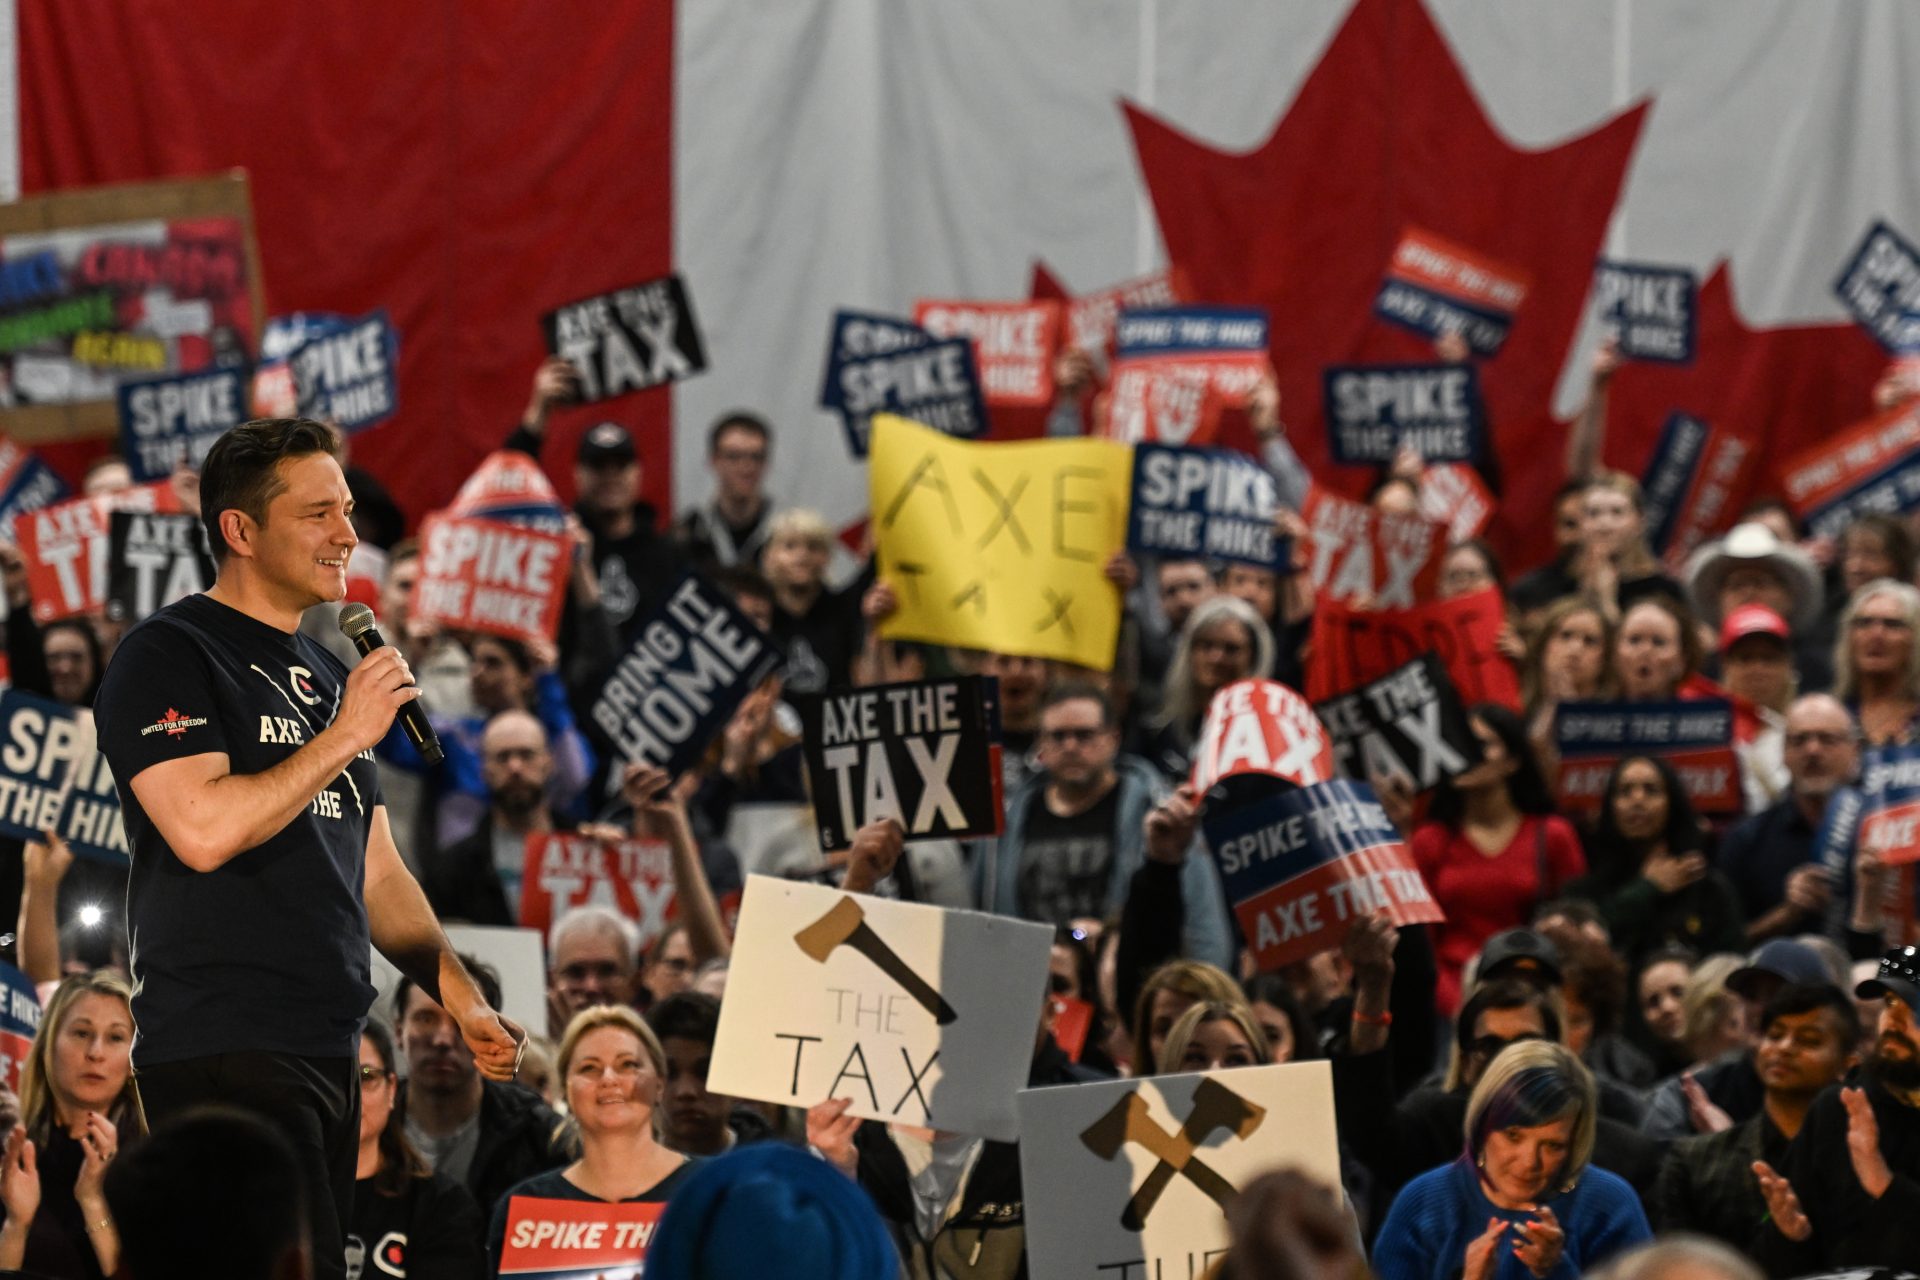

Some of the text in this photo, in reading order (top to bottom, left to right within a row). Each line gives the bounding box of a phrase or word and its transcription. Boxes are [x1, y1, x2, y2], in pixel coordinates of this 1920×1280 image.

[559, 312, 692, 399] TAX
[130, 373, 238, 437] SPIKE
[1334, 370, 1470, 422] SPIKE
[883, 453, 1108, 563] AXE
[1140, 452, 1278, 519] SPIKE
[125, 550, 205, 620] TA
[425, 521, 560, 594] SPIKE
[895, 560, 1076, 641] TAX
[592, 577, 715, 743] BRING IT
[617, 606, 763, 770] HOME
[141, 717, 207, 736] UNITED FOR FREEDOM
[260, 716, 305, 745] AXE
[822, 684, 961, 745] AXE THE
[3, 707, 117, 797] SPI
[822, 732, 969, 843] TAX
[67, 799, 131, 854] HIK
[1219, 814, 1307, 875] SPIKE
[1256, 891, 1325, 952] AXE
[826, 987, 910, 1035] THE
[775, 1033, 940, 1121] TAX
[511, 1219, 660, 1250] SPIKE TH
